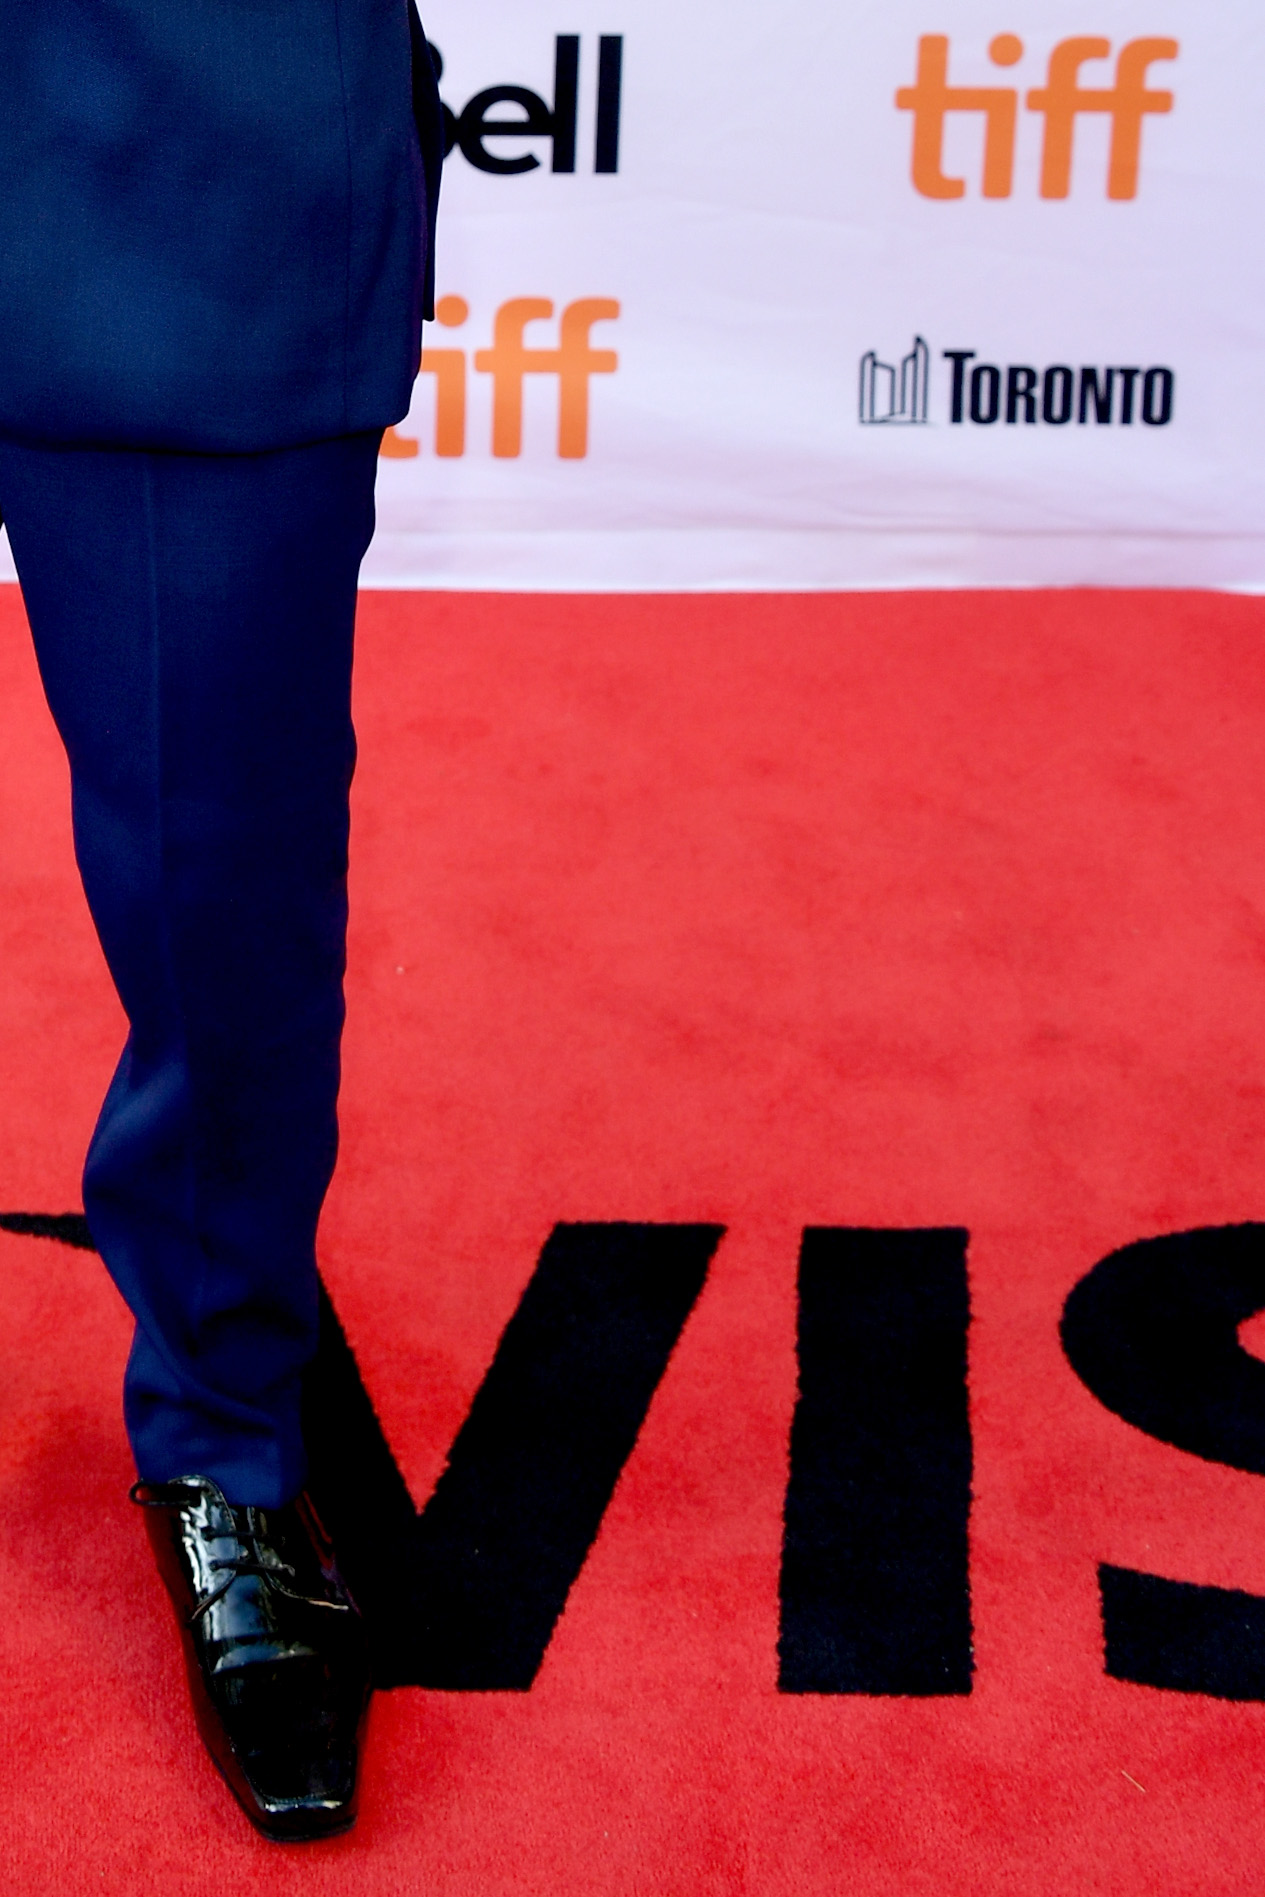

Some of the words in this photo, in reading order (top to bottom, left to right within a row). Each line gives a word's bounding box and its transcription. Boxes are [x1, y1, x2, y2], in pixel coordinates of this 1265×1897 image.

[428, 33, 624, 176] ell
[895, 33, 1179, 201] tiff
[378, 294, 620, 460] iff
[942, 349, 1175, 427] TORONTO
